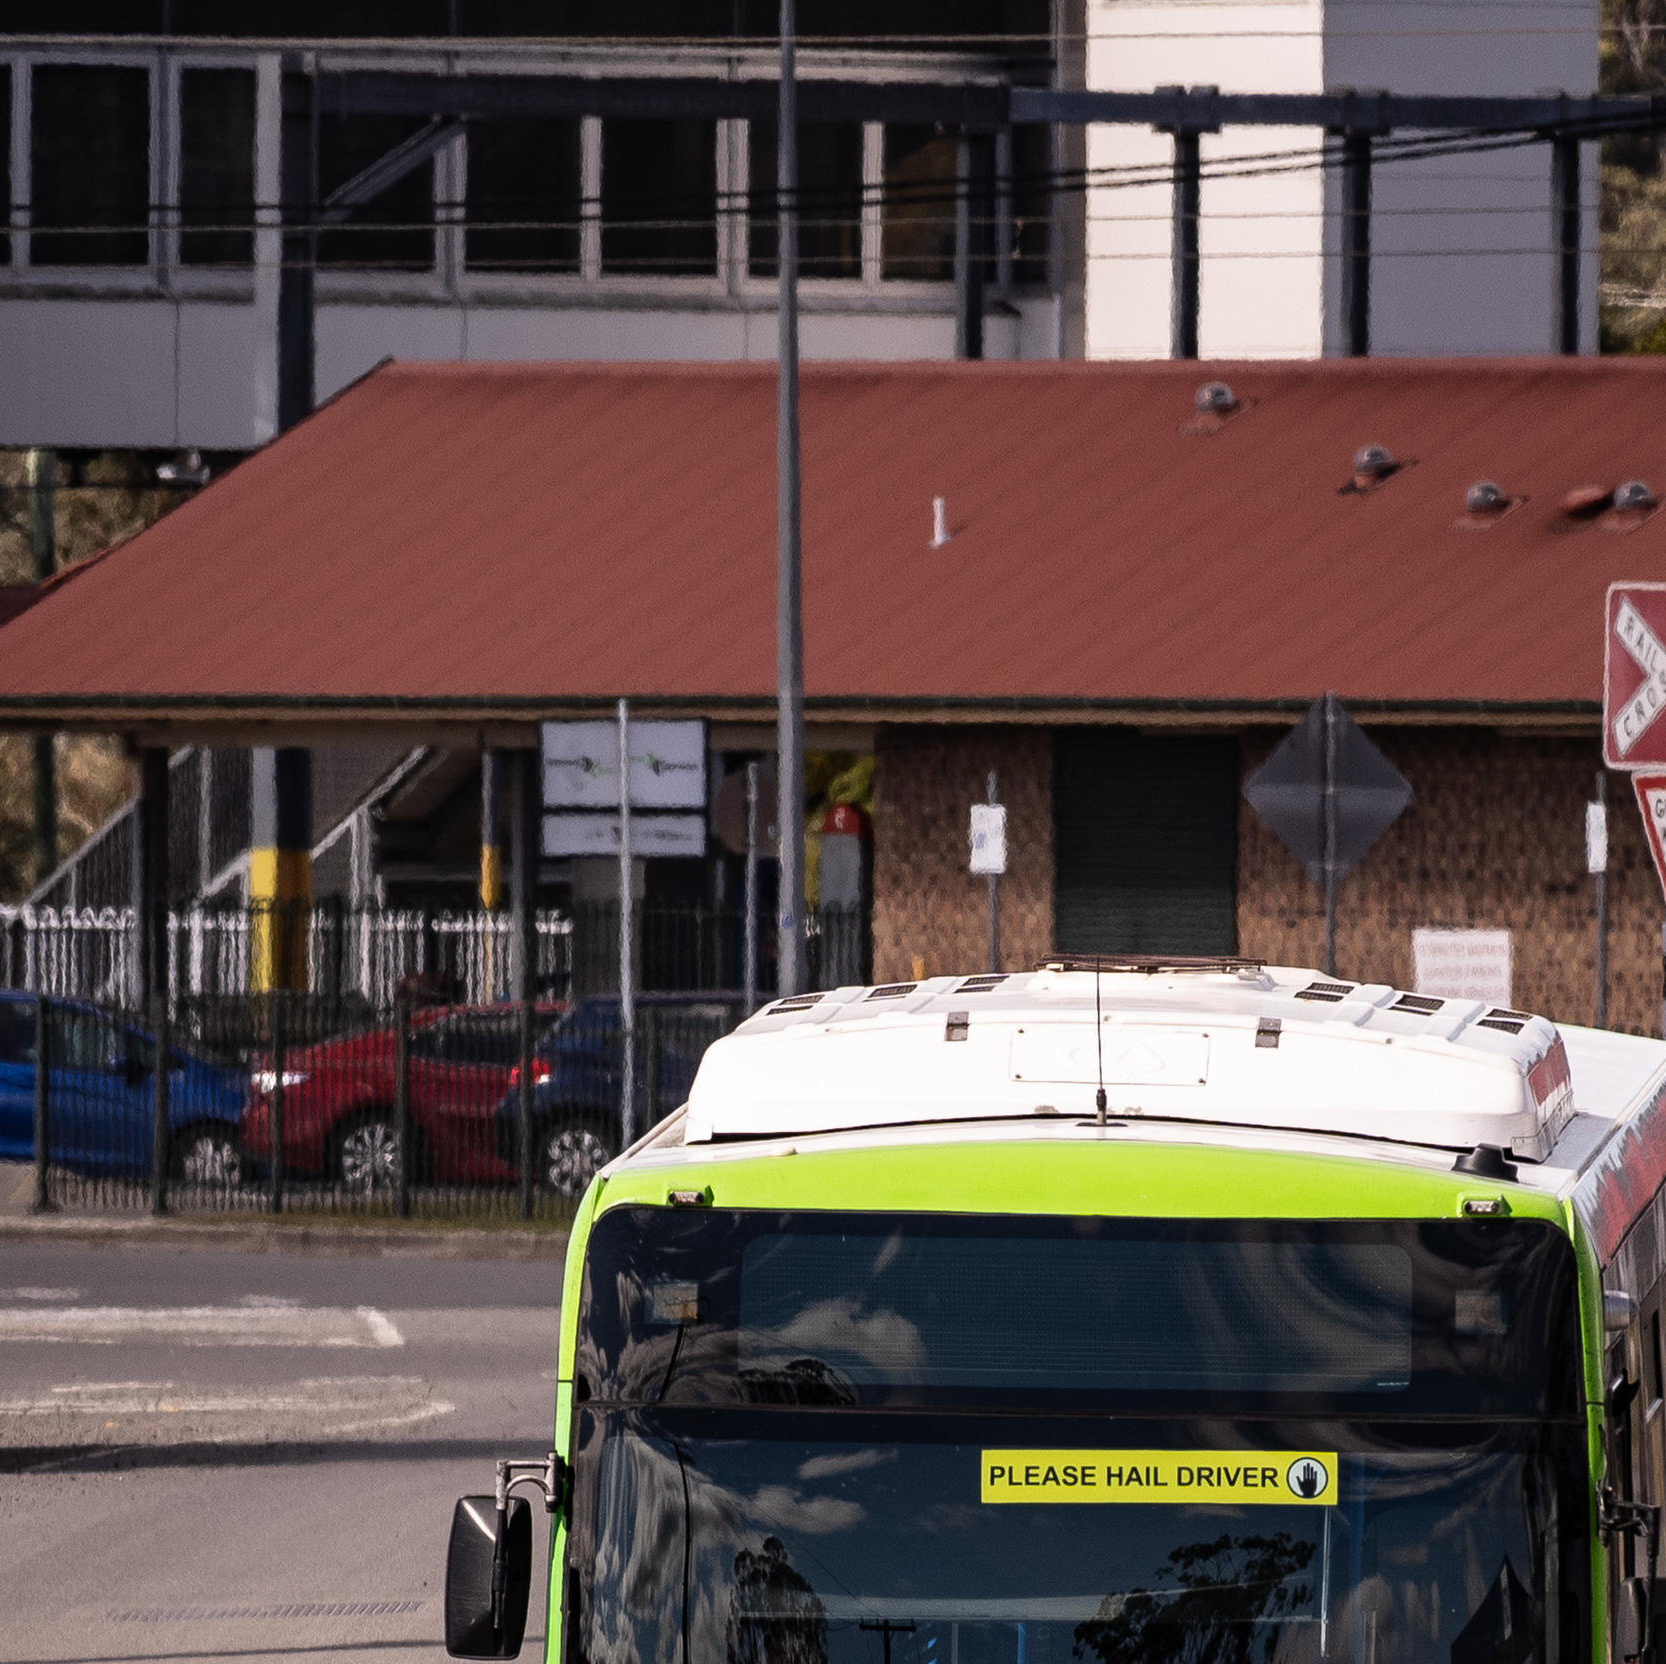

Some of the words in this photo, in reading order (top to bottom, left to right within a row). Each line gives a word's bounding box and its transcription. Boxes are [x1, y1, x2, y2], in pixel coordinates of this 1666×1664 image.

[989, 1465, 1097, 1487] PLEASE
[1106, 1466, 1168, 1487] HAIL
[1177, 1466, 1279, 1488] DRIVER
